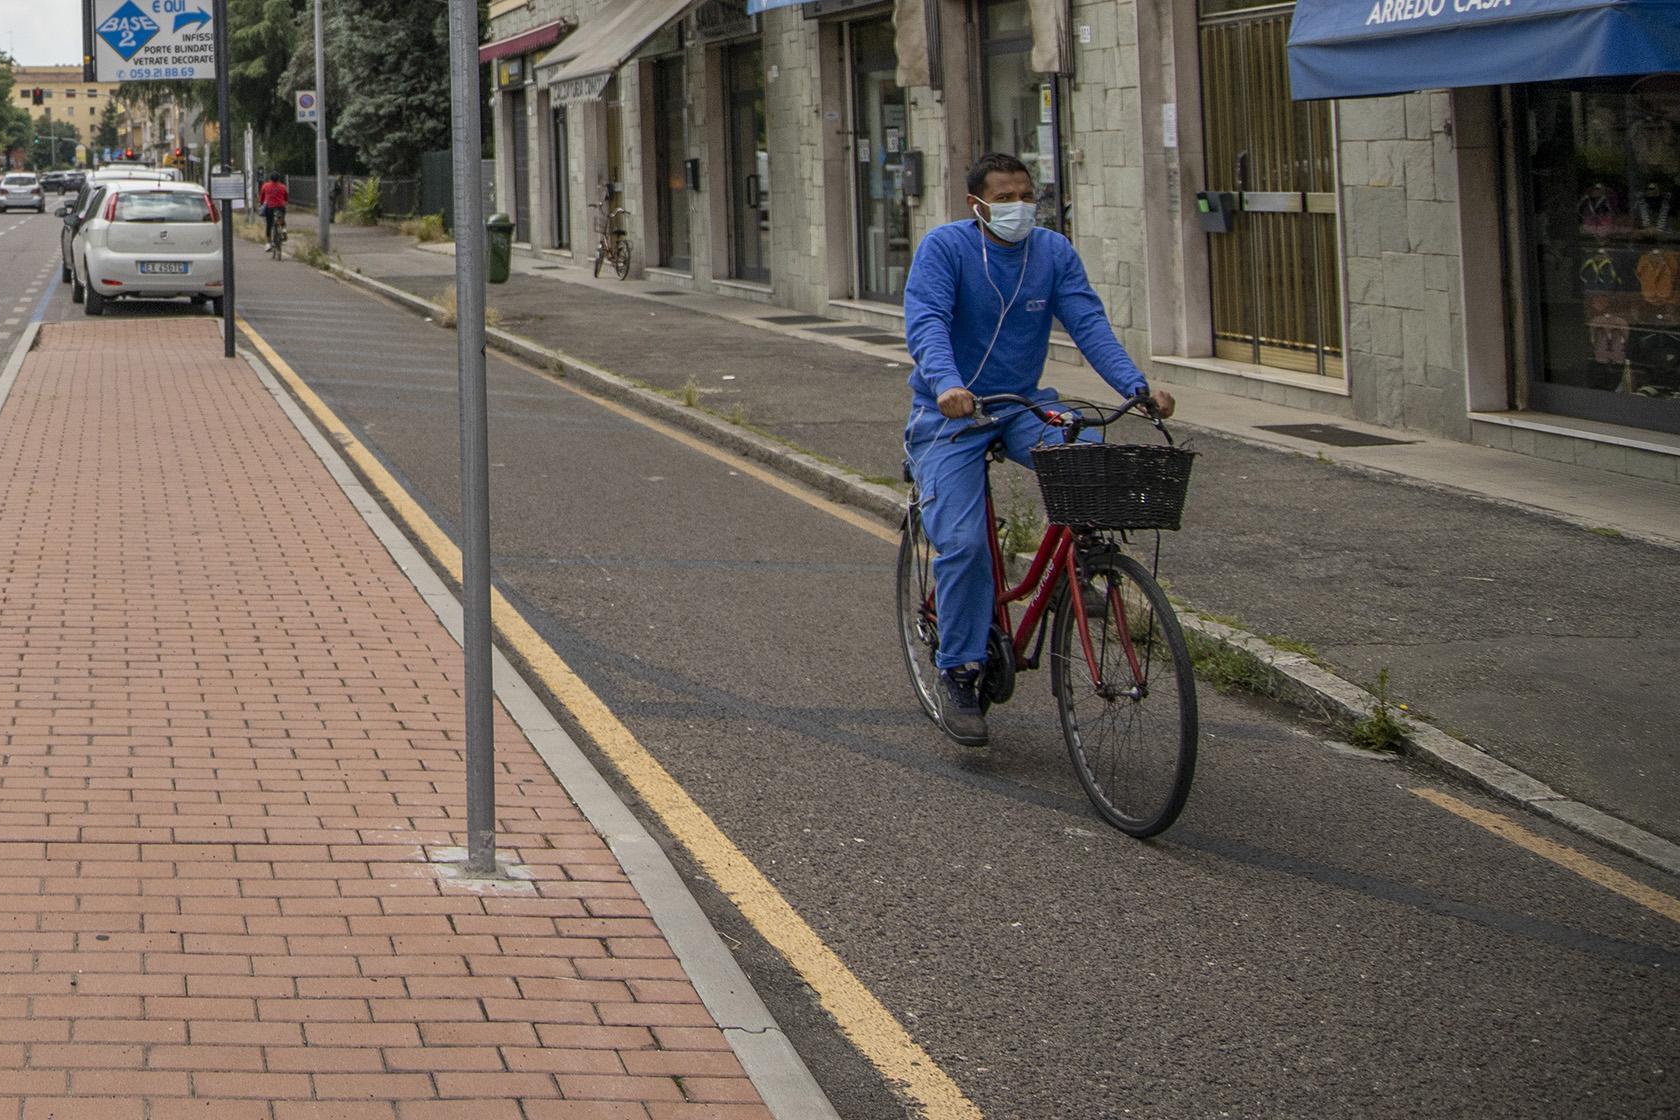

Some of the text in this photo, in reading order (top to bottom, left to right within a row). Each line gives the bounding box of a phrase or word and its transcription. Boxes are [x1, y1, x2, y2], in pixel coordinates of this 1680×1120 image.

[164, 0, 186, 13] QUI
[100, 15, 159, 32] BASE
[118, 30, 137, 47] 2
[182, 33, 214, 42] INFISSI
[144, 44, 214, 54] PORTE BLINDATE
[133, 55, 214, 66] VETRATE DECORATE
